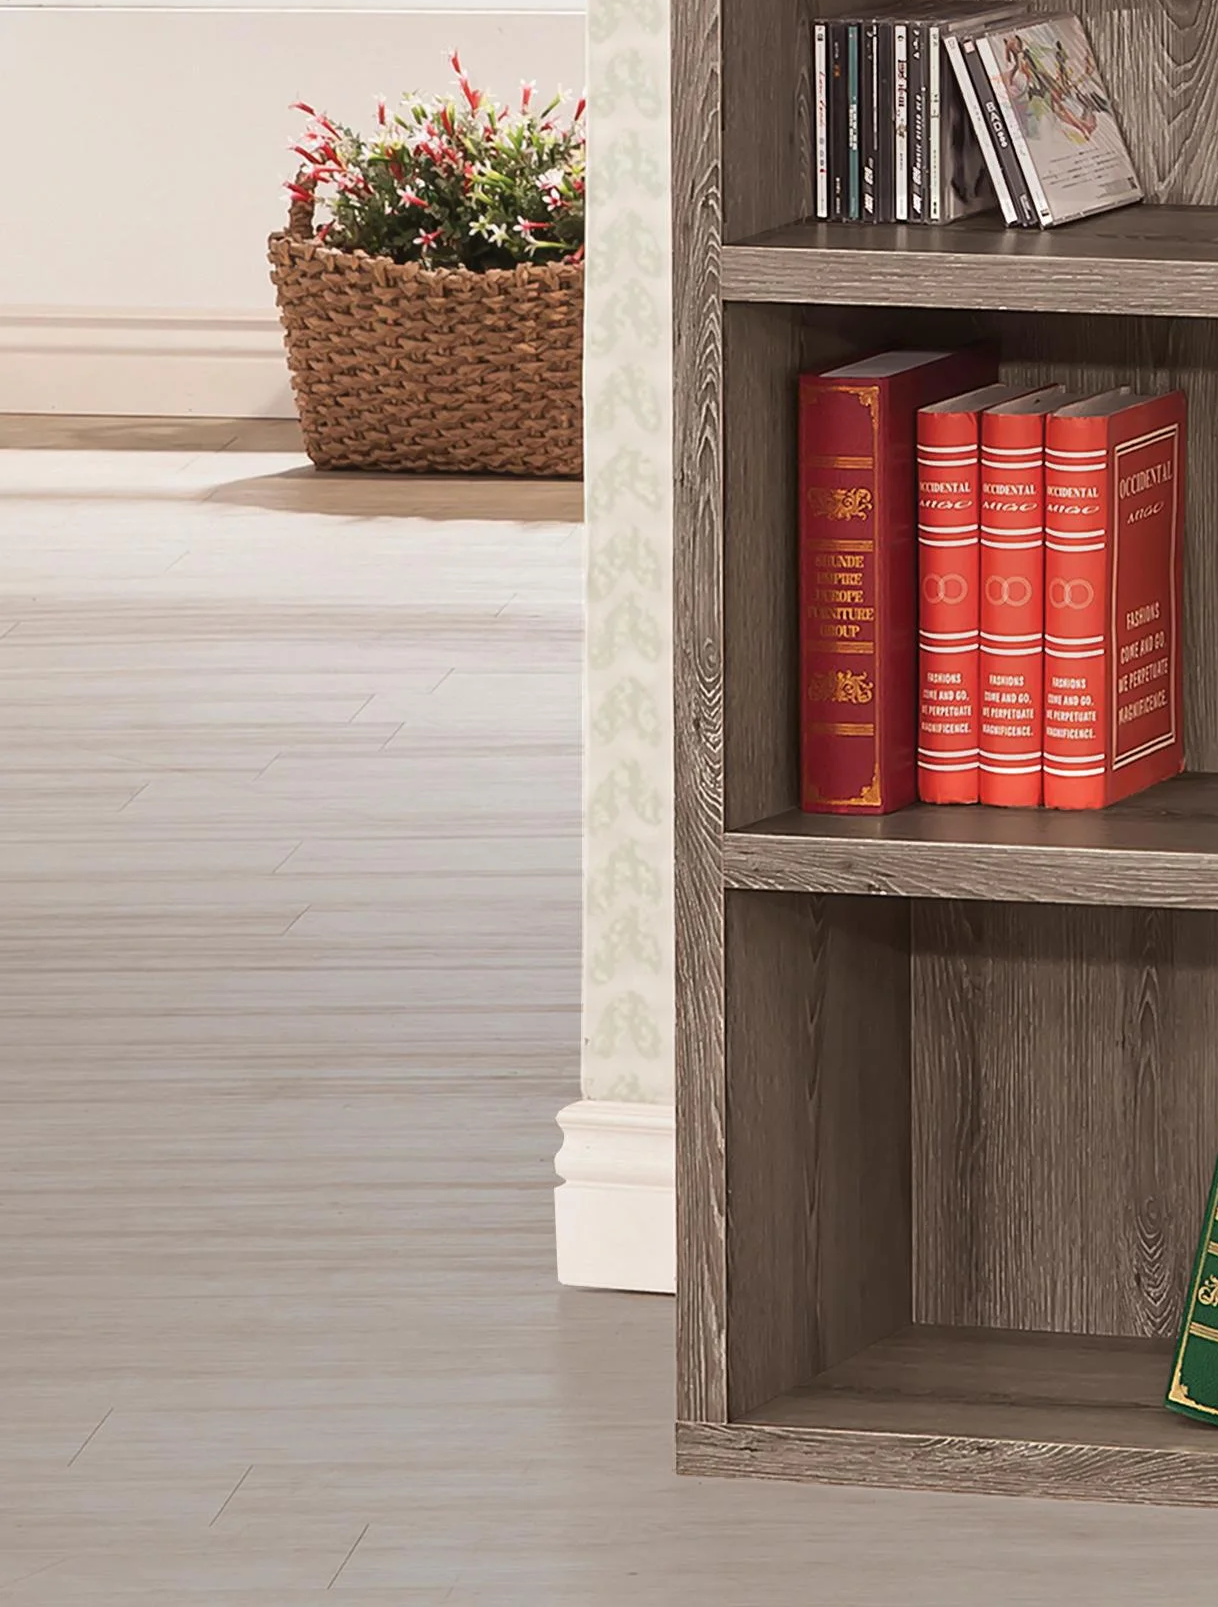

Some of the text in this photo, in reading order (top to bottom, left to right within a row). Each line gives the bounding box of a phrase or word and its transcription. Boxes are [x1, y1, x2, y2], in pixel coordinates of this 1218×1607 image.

[1120, 460, 1172, 499] OCCIDENTAL
[1127, 601, 1159, 630] FASHIONS
[1140, 635, 1153, 657] AND
[928, 672, 961, 683] FASHIONS
[1129, 657, 1168, 690] PERPETUATE
[989, 674, 1024, 686] FASHIONS
[1052, 677, 1086, 689] FASHIONS
[939, 690, 954, 701] AND
[1001, 693, 1017, 703] AND
[1063, 695, 1079, 706] AND
[929, 705, 971, 716] PERPETUATE
[991, 708, 1034, 719] PERPETUATE
[1054, 711, 1096, 722] PERPETUATE
